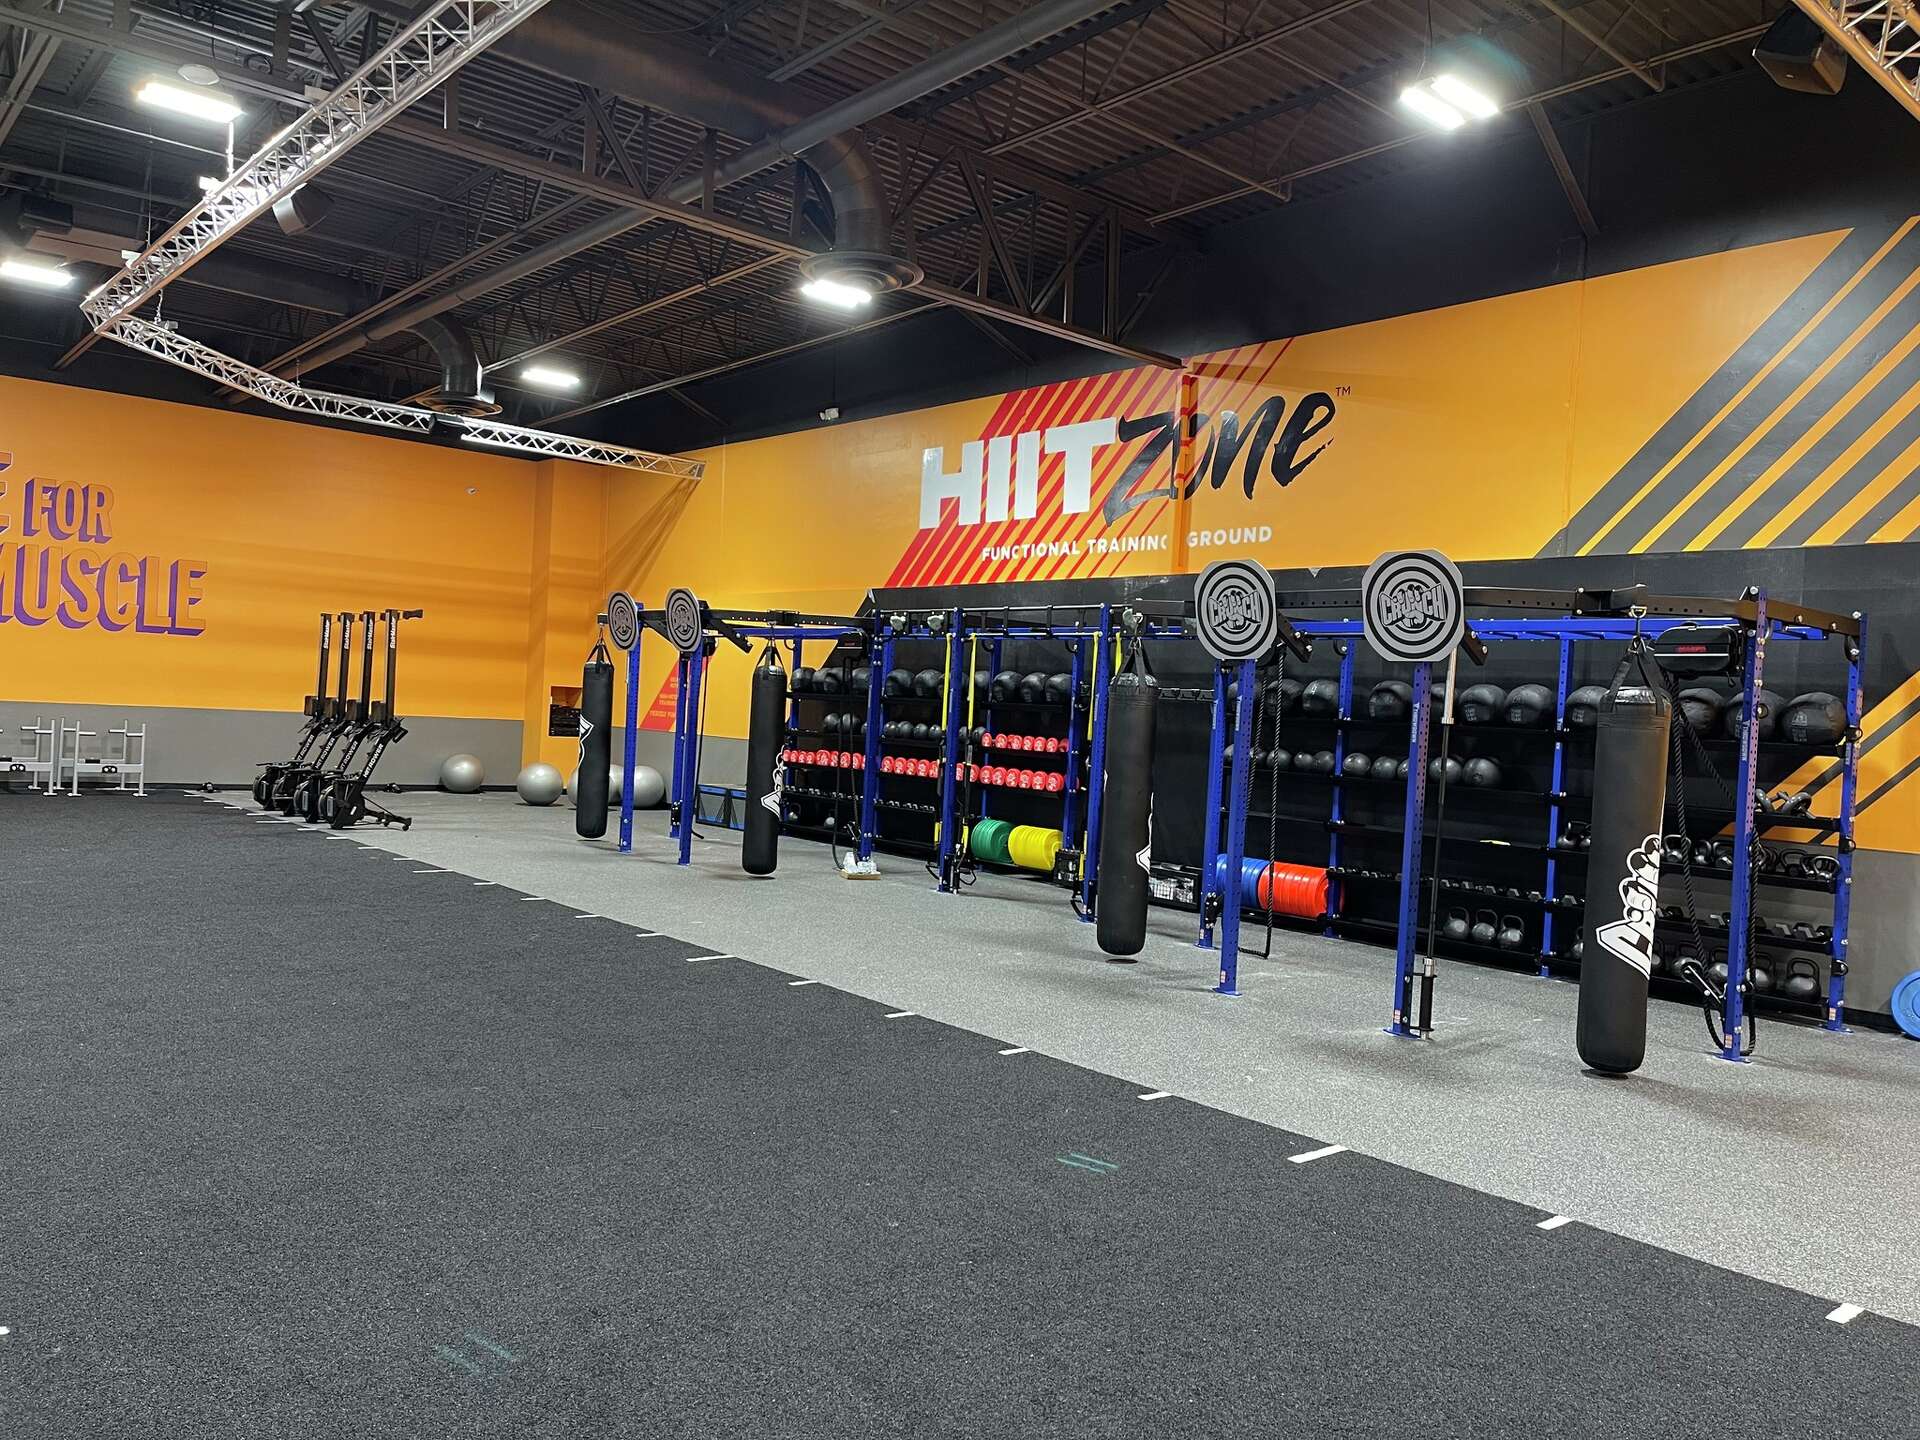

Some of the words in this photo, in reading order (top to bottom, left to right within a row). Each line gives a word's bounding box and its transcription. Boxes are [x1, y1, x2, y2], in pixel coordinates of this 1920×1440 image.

[919, 417, 1117, 529] HIIT
[1335, 386, 1351, 397] TM
[23, 477, 114, 544] FOR
[982, 541, 1081, 561] FUNCTIONAL
[1187, 526, 1272, 548] GROUND
[1207, 590, 1263, 628] CRUNCH
[1379, 583, 1447, 628] CRUNCH
